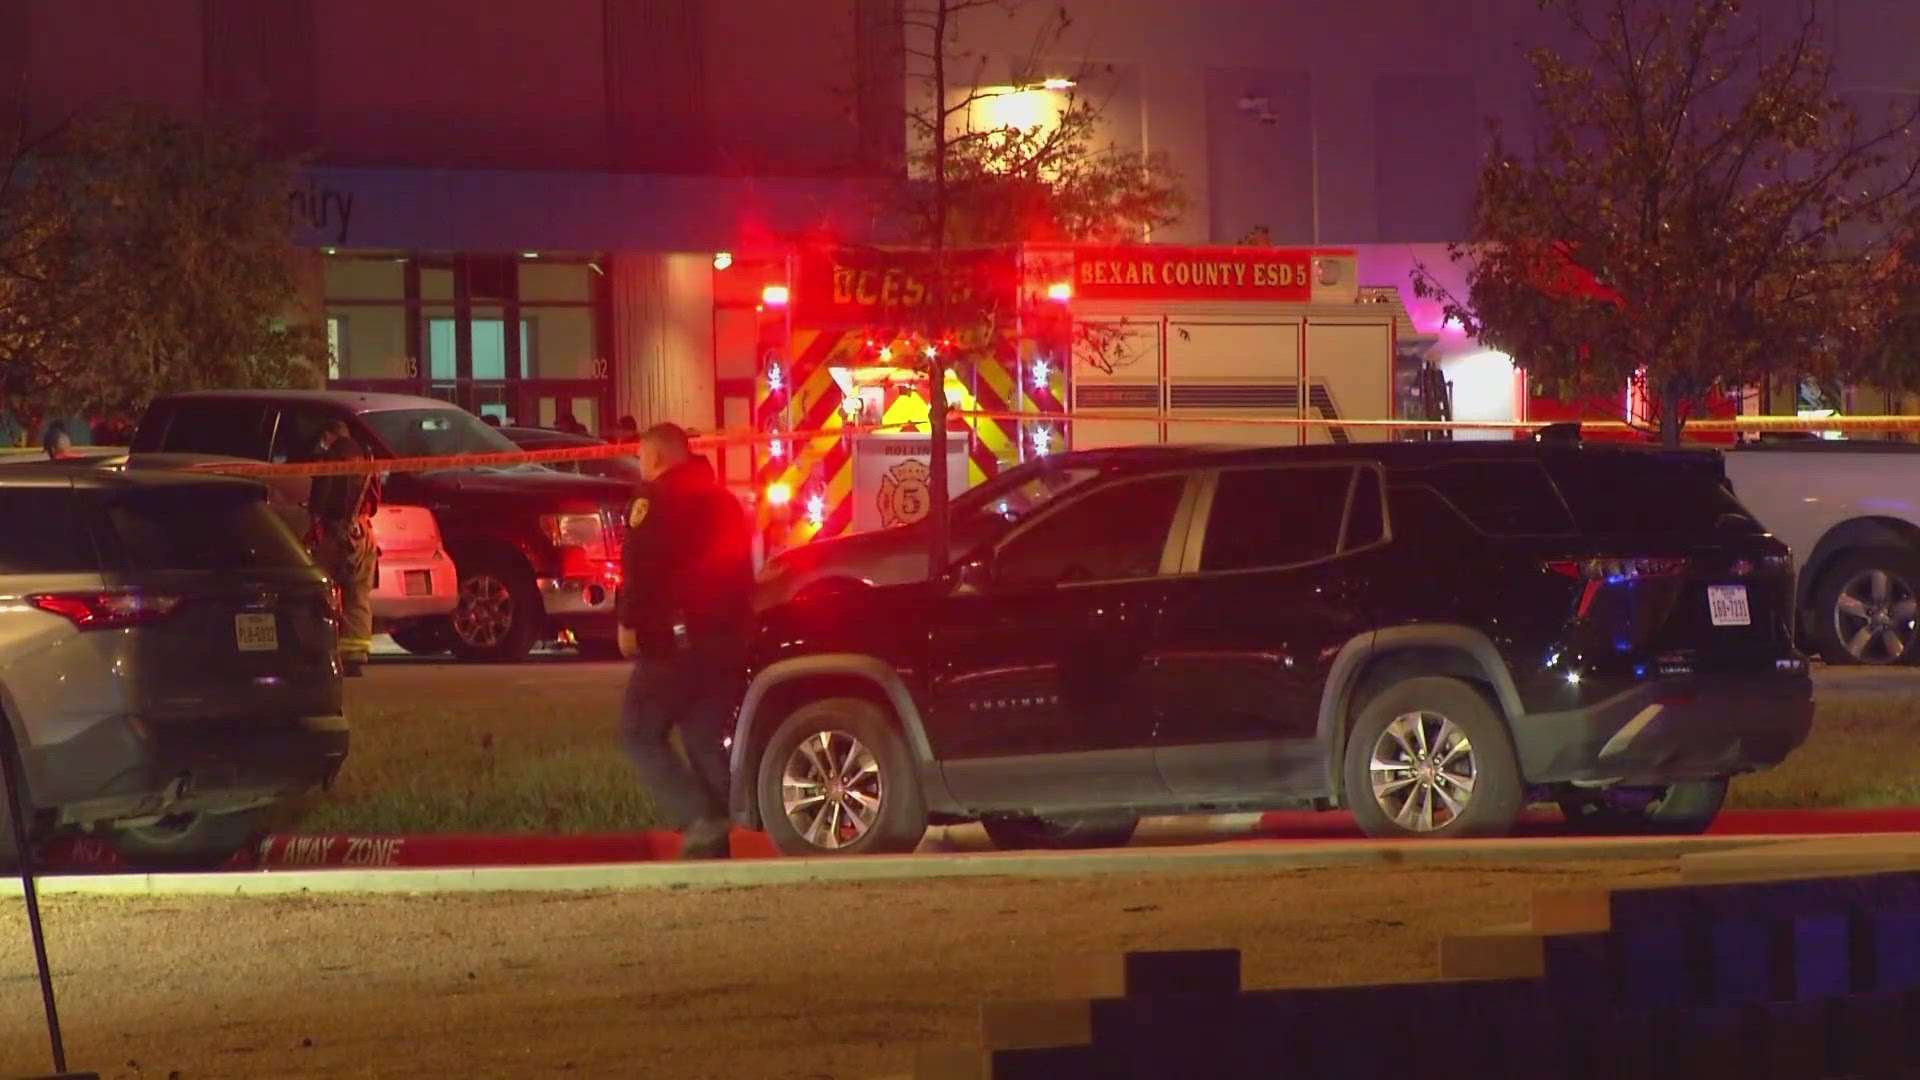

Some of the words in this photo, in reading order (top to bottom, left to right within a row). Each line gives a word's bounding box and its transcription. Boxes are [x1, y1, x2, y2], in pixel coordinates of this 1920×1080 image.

[1081, 262, 1156, 284] BEXAR
[1162, 263, 1246, 286] COUNTY
[1253, 264, 1291, 286] ESD
[1296, 265, 1306, 286] 5
[903, 489, 919, 514] 5
[283, 836, 335, 864] AWAY
[343, 838, 405, 866] ZONE
